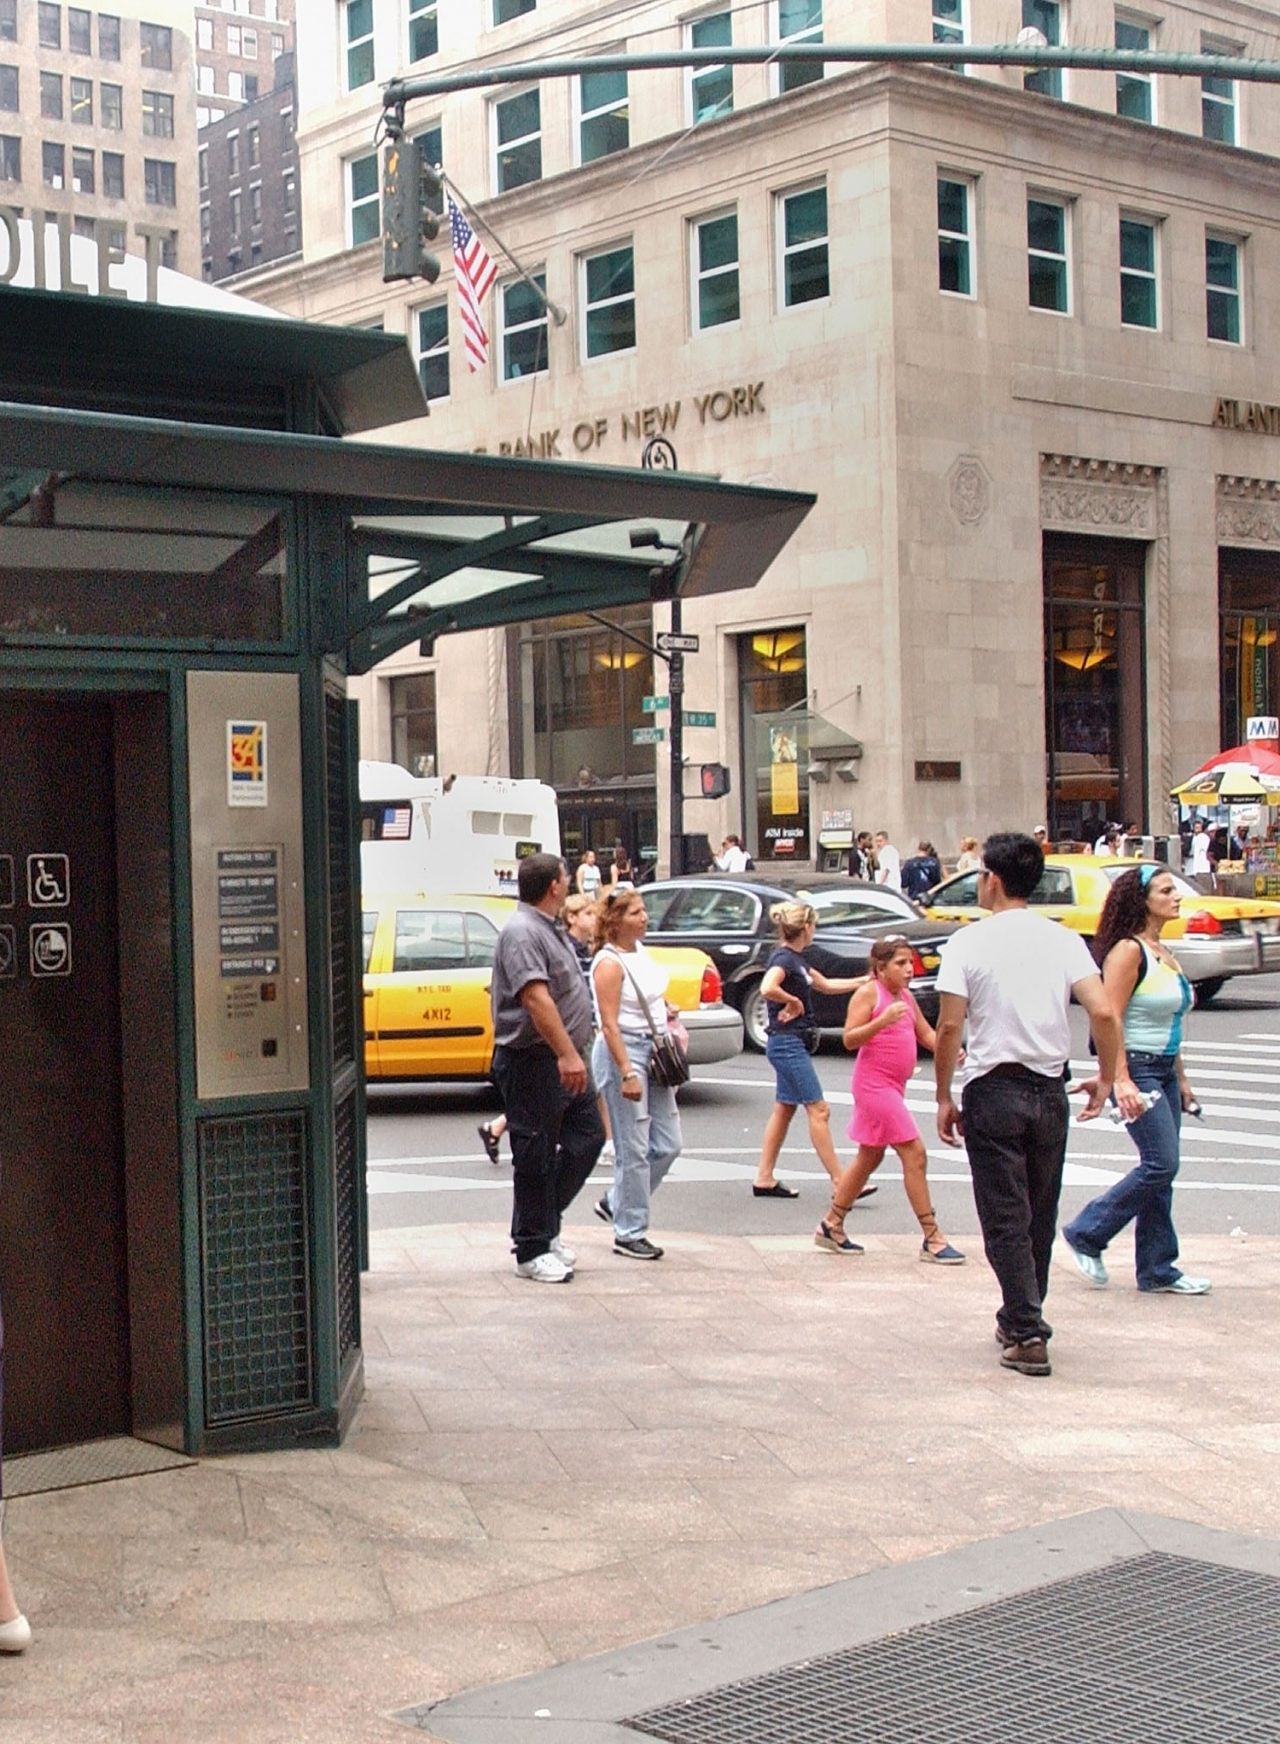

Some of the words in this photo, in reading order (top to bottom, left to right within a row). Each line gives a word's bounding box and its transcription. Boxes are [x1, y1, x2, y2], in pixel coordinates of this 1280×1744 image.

[572, 418, 609, 452] OF
[620, 401, 681, 442] NEW
[693, 381, 766, 425] YORK
[422, 1008, 452, 1021] 4X12
